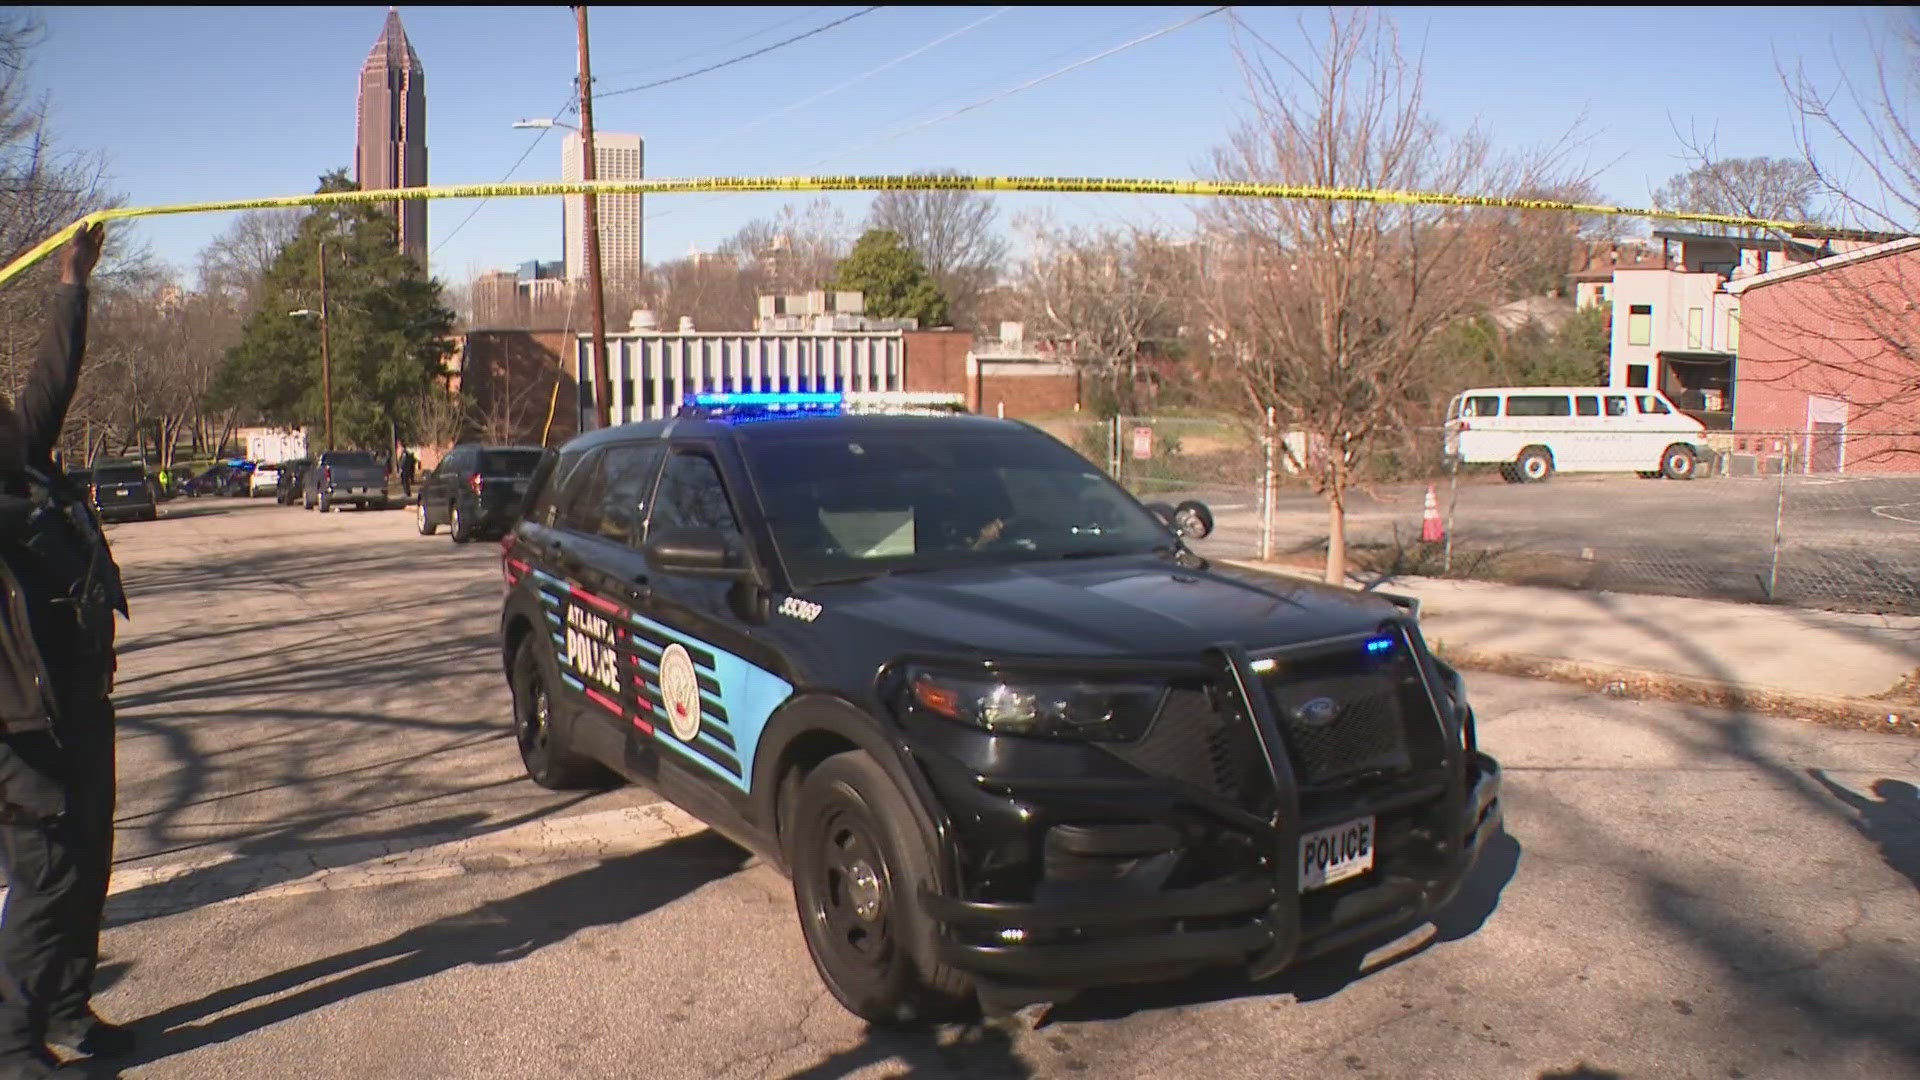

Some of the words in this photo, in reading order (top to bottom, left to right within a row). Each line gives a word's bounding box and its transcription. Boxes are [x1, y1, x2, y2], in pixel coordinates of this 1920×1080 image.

[567, 603, 615, 646] ATLANTA
[567, 626, 621, 693] POLICE
[1304, 823, 1369, 875] POLICE
